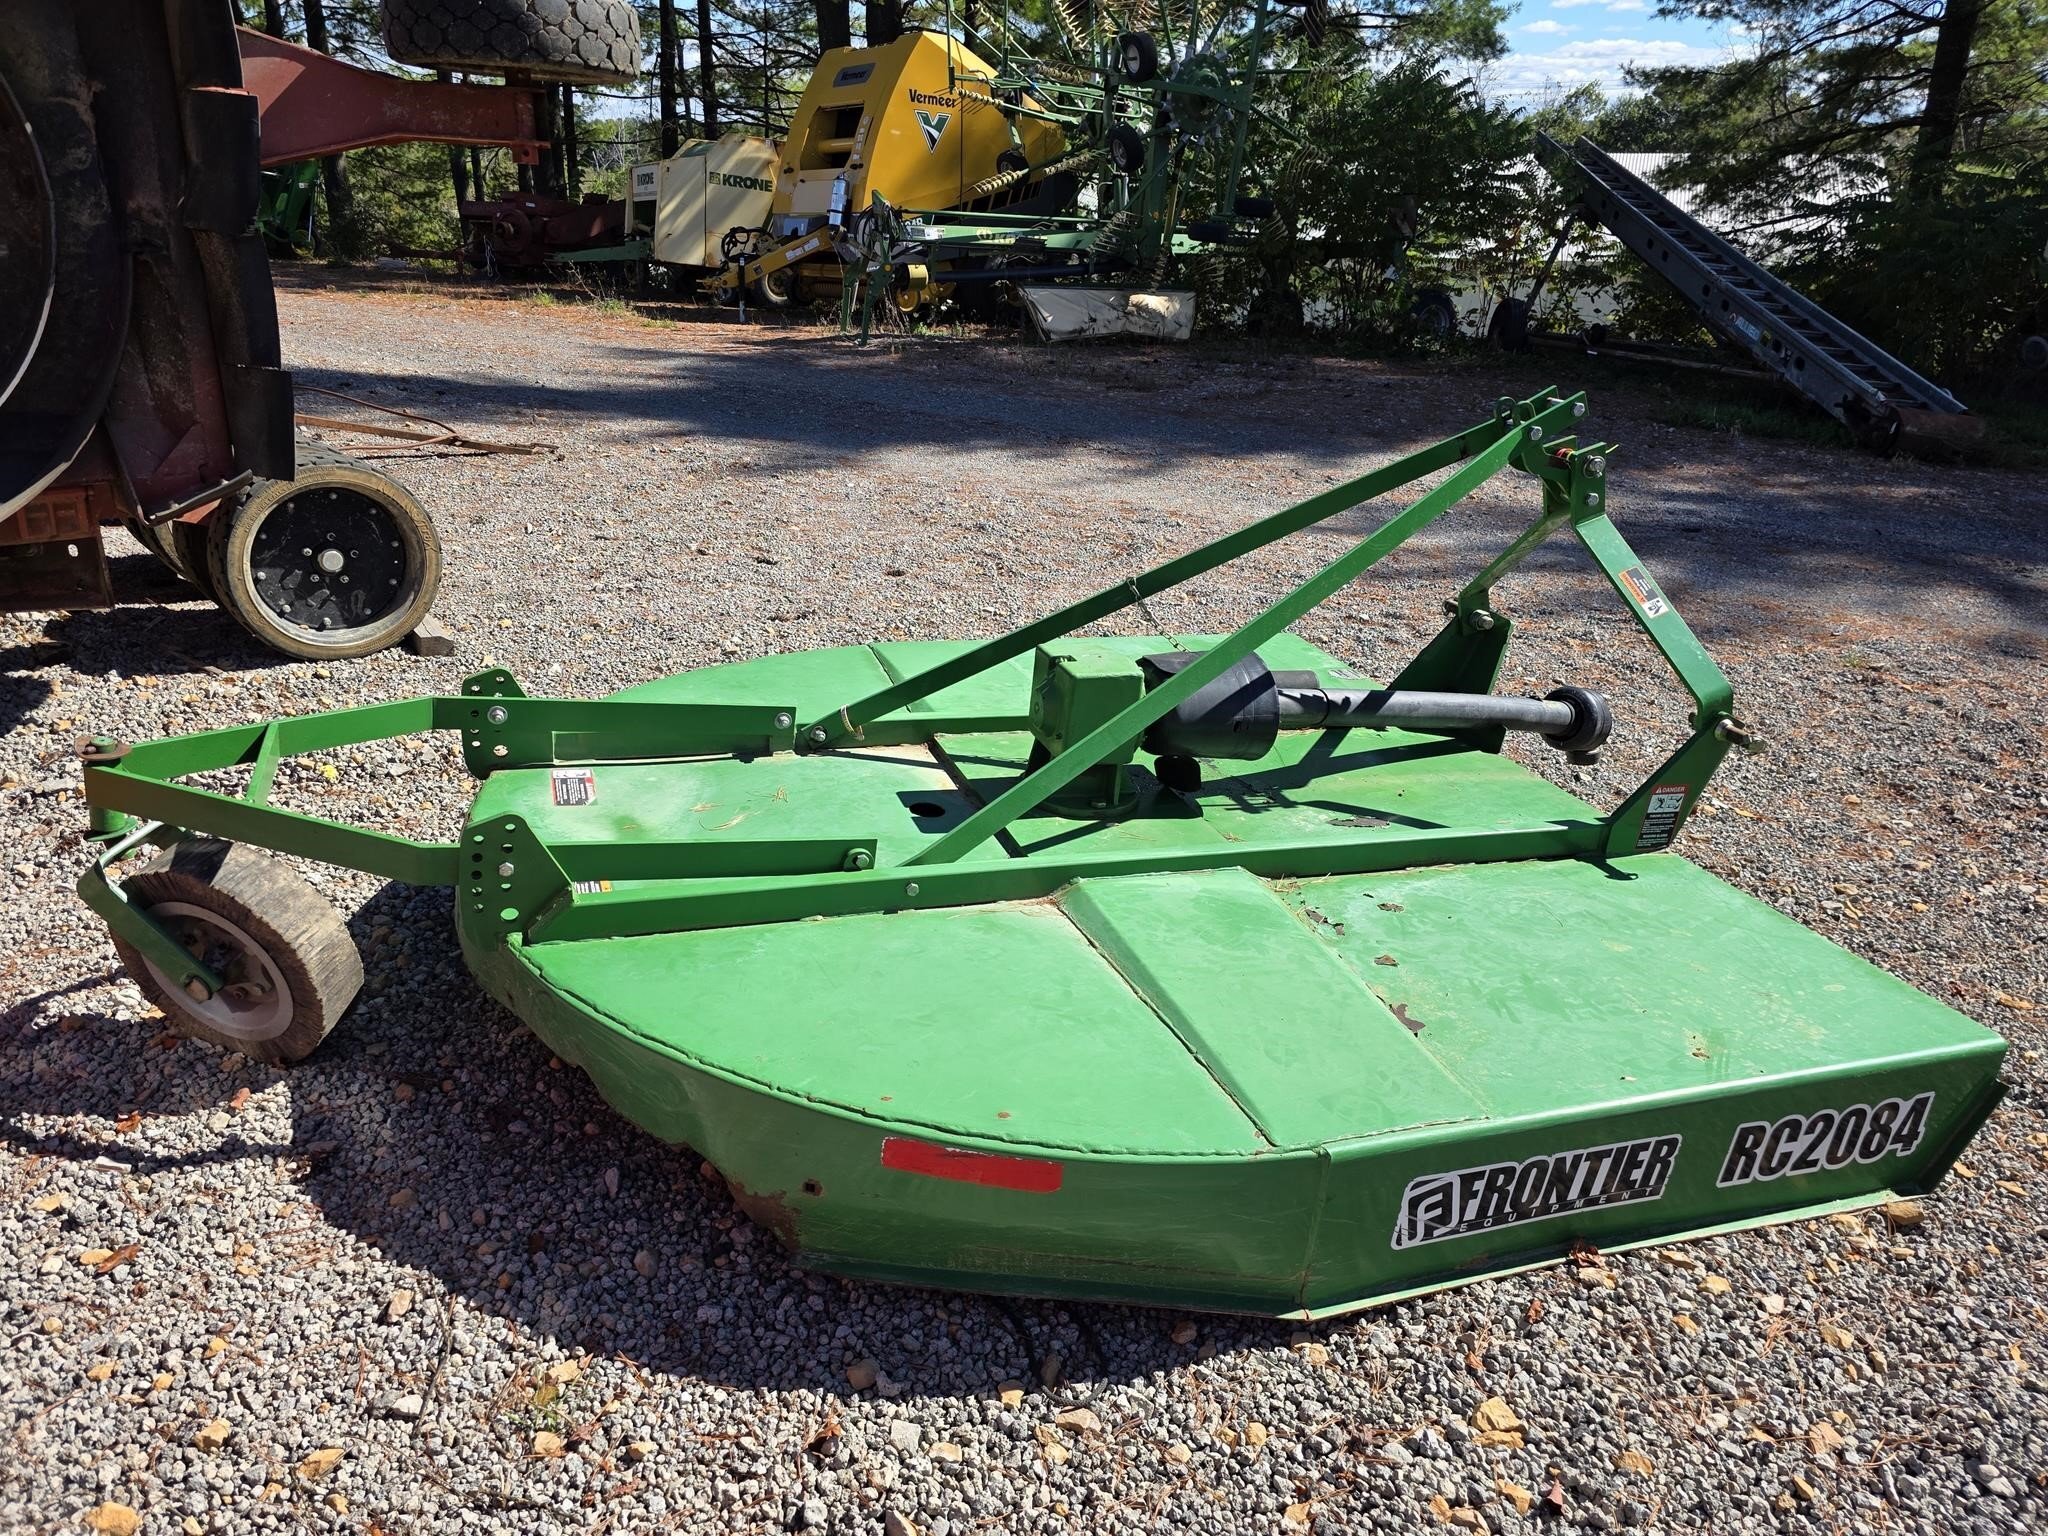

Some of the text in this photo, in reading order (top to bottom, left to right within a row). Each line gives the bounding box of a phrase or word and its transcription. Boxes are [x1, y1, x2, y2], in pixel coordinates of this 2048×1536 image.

[909, 89, 957, 108] Vermeer
[722, 173, 773, 193] KRONE
[1719, 1095, 1932, 1183] RC2084
[1457, 1136, 1679, 1222] FRONTIER
[1458, 1187, 1656, 1232] EQUIPMENT
